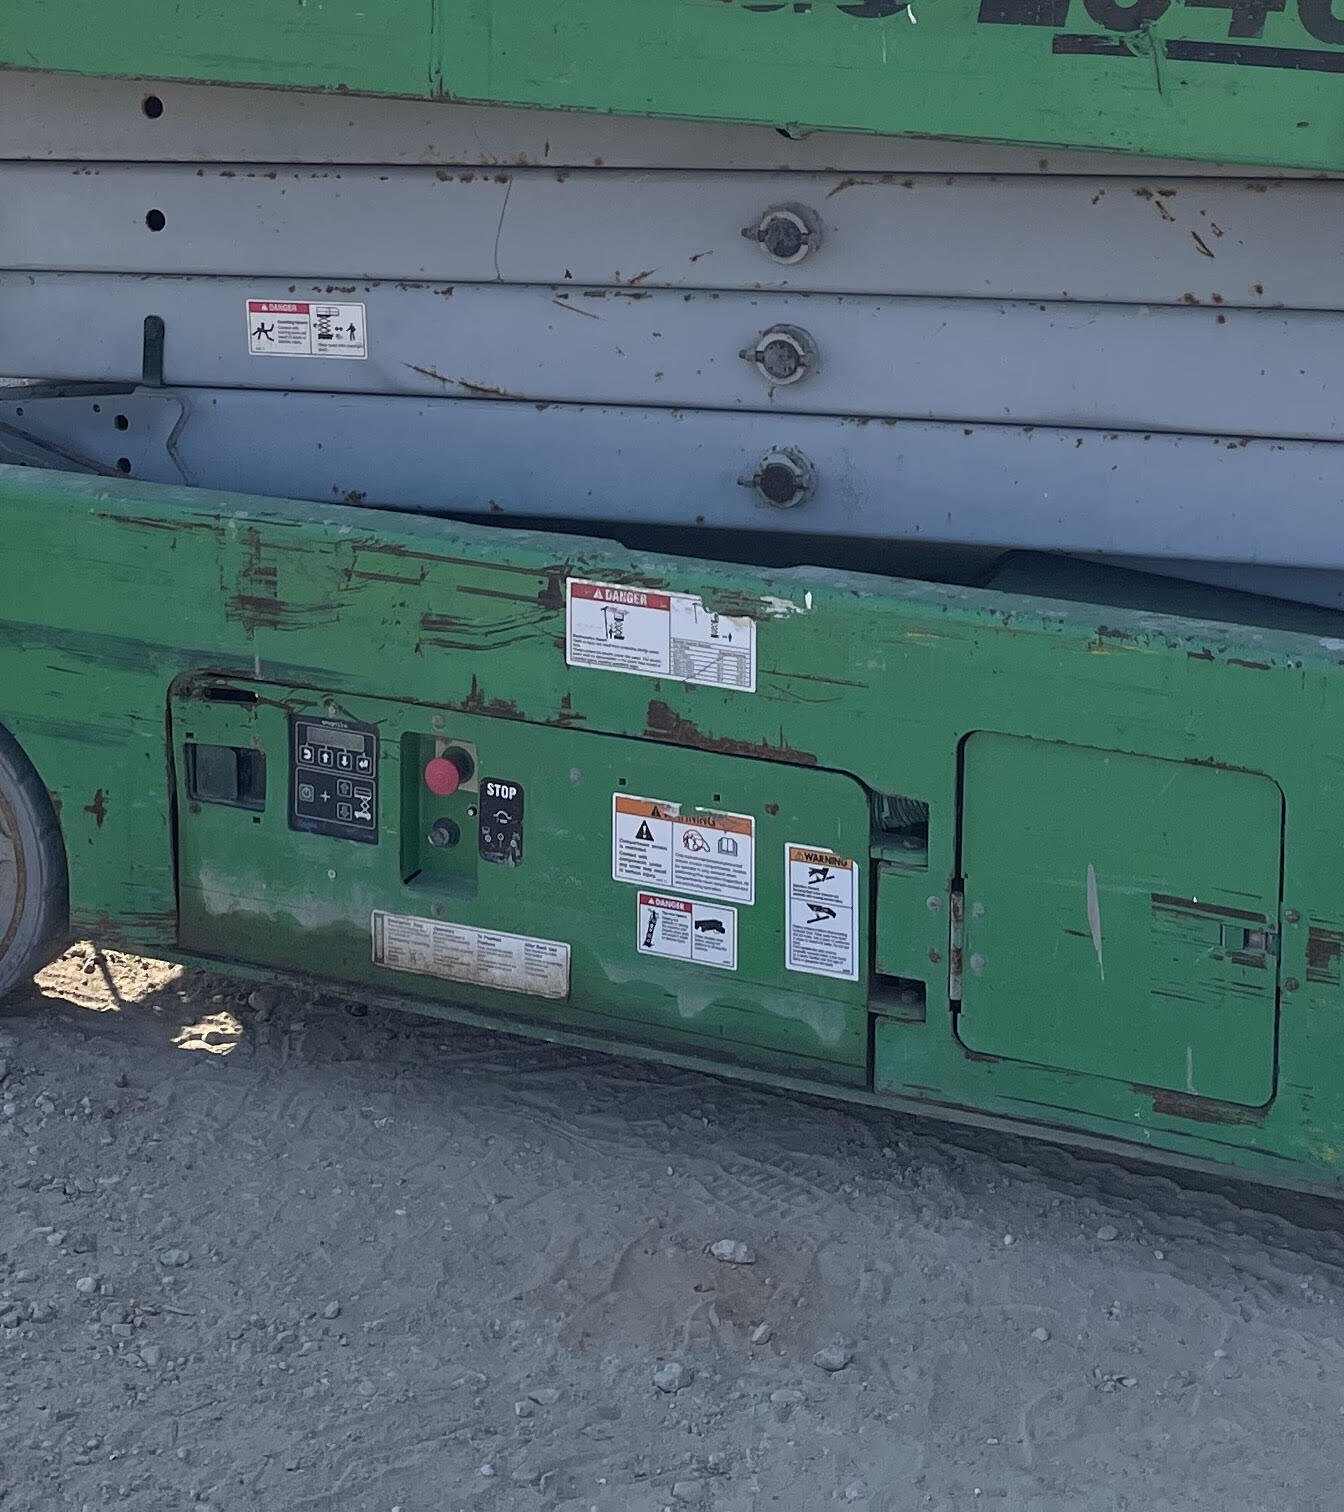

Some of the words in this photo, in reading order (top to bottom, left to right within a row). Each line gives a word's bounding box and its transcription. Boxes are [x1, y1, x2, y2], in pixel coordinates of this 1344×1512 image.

[268, 303, 297, 313] DANGER
[605, 589, 648, 606] DANGER
[486, 782, 517, 801] STOP
